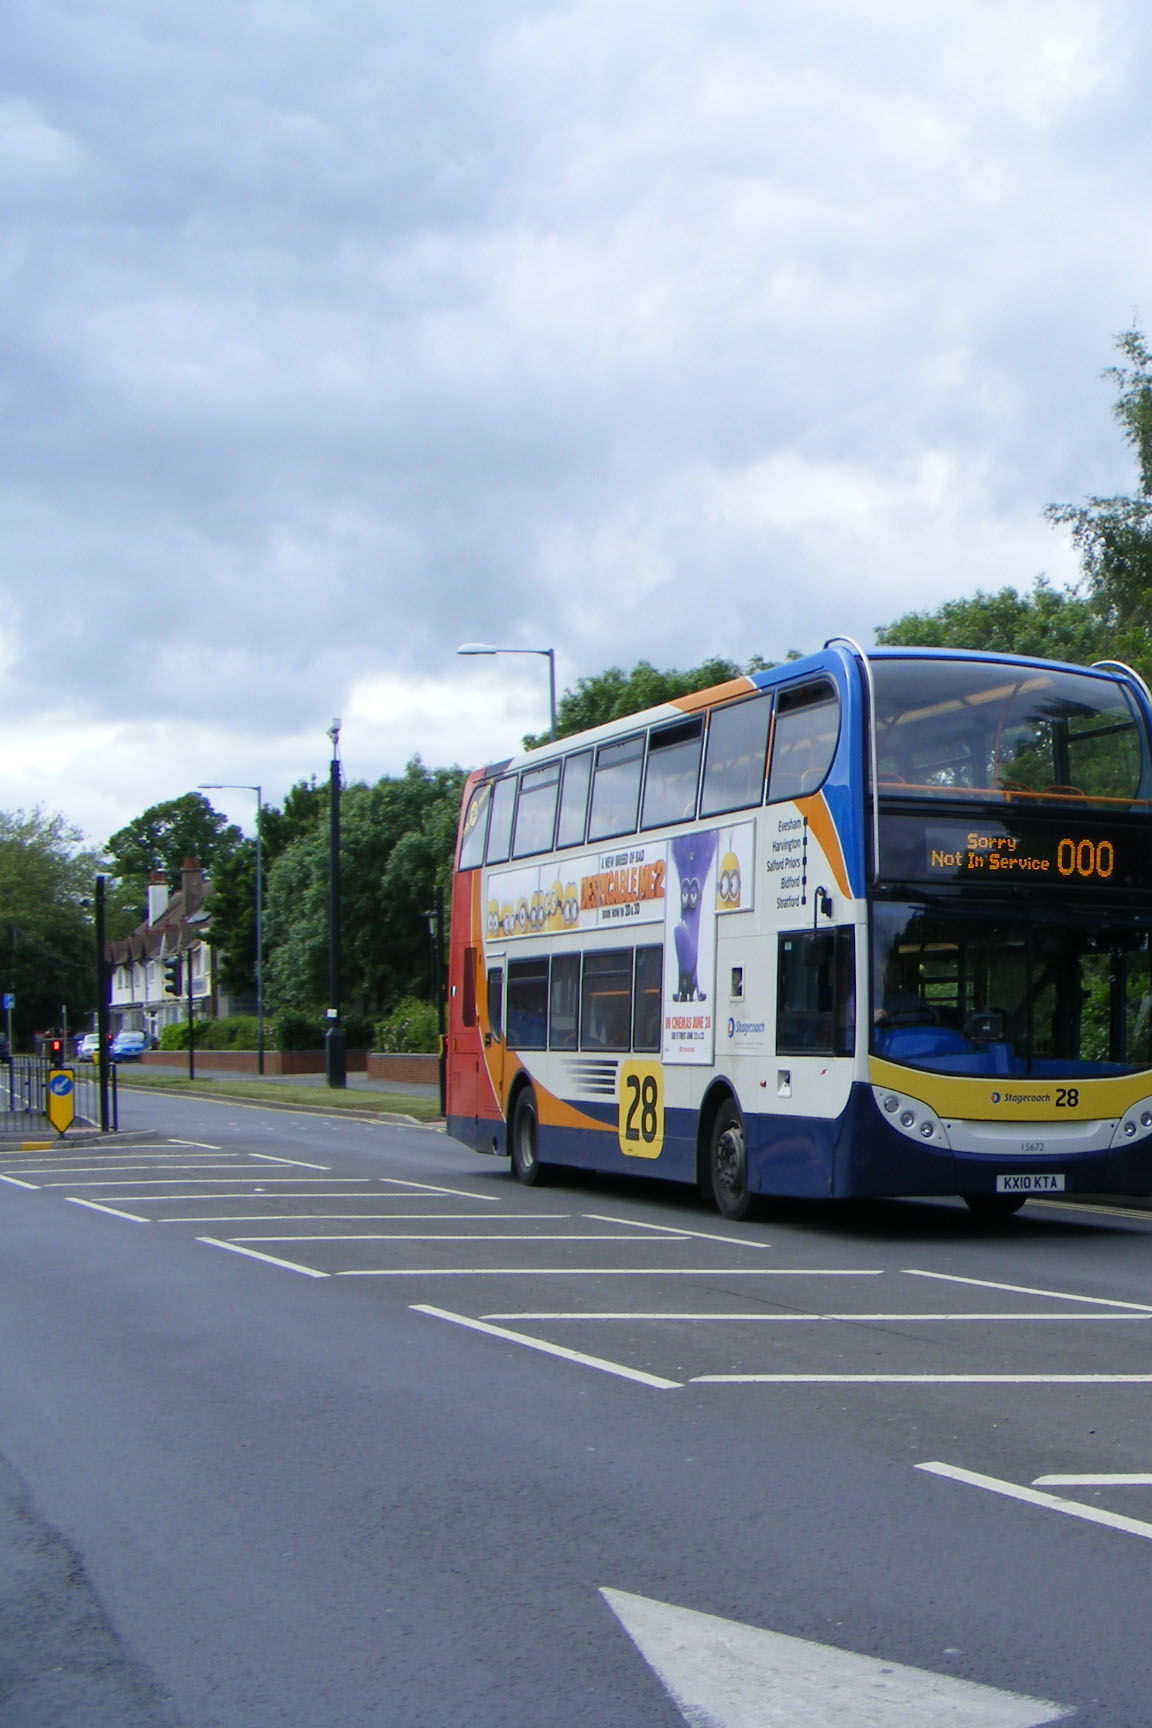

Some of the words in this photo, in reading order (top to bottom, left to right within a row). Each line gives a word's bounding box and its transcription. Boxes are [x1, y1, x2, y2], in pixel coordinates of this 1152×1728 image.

[778, 818, 802, 832] Evesham
[772, 838, 800, 853] Harvington
[967, 832, 1017, 852] Sorry
[766, 860, 784, 872] Salford
[785, 857, 800, 870] Priors
[930, 850, 962, 867] Not
[967, 852, 984, 869] In
[988, 853, 1050, 871] Service
[1057, 838, 1114, 878] 000
[581, 867, 638, 910] DESPICABLE
[780, 876, 800, 890] Bidford
[776, 895, 800, 910] Stratford
[666, 1016, 671, 1030] IN
[672, 1016, 692, 1030] CINEMAS
[692, 1016, 704, 1029] JUNE
[736, 1020, 765, 1036] Stagecoach
[1004, 1093, 1051, 1104] Stagecoach
[1055, 1088, 1079, 1108] 28
[626, 1074, 658, 1143] 28
[1021, 1143, 1045, 1152] 15672
[1004, 1176, 1031, 1189] KX10
[1034, 1176, 1058, 1189] KTA
